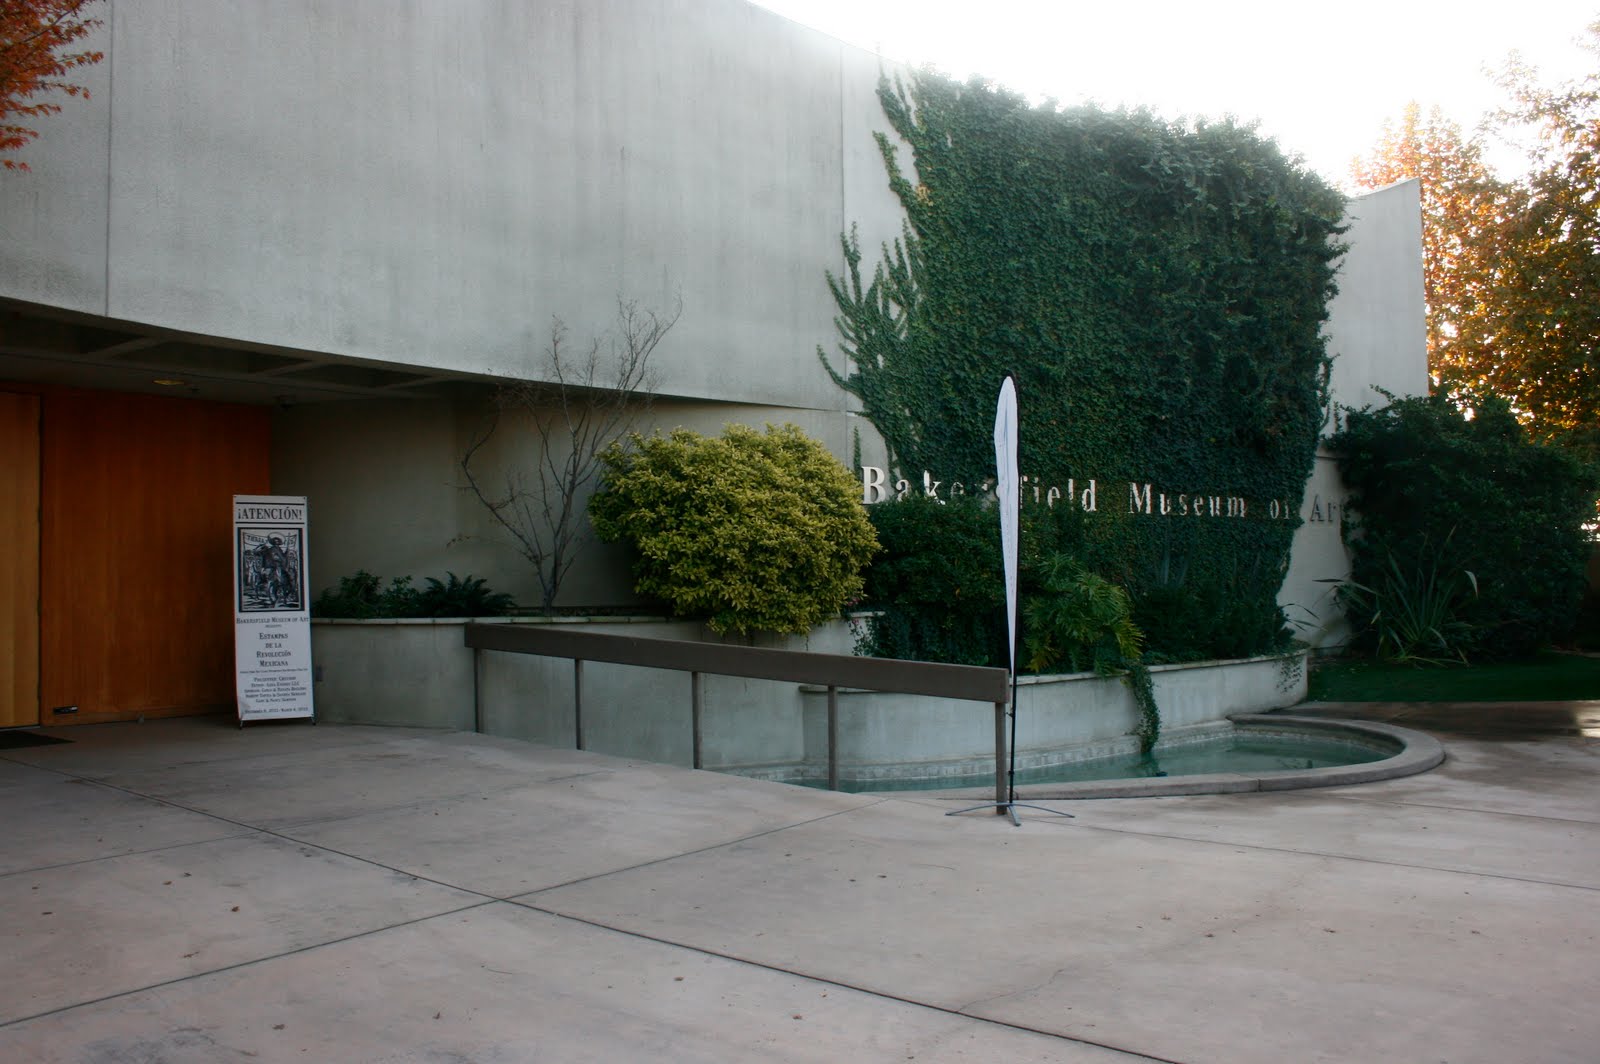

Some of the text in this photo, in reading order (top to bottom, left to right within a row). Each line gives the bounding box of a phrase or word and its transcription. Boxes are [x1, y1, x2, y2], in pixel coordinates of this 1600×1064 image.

[1128, 481, 1246, 518] Museum
[238, 506, 302, 520] ¡ATENCIÓN!
[259, 632, 288, 640] ESTAMPAS
